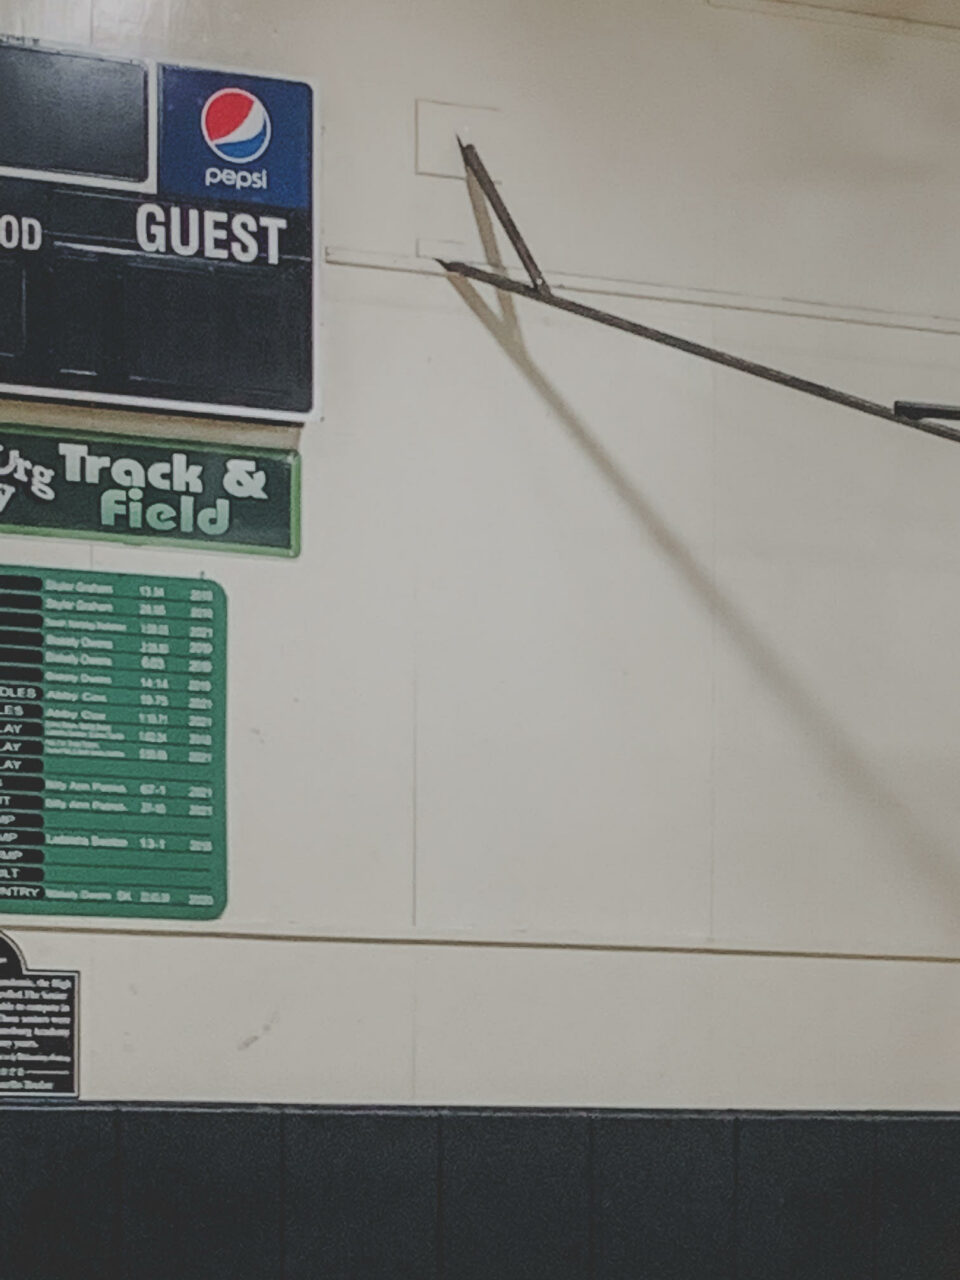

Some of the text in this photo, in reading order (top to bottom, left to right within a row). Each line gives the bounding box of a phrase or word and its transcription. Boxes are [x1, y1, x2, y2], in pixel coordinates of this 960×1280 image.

[205, 167, 267, 190] pepsi
[136, 203, 287, 265] GUEST
[58, 442, 203, 493] Track
[223, 459, 268, 500] &
[101, 488, 230, 535] Field
